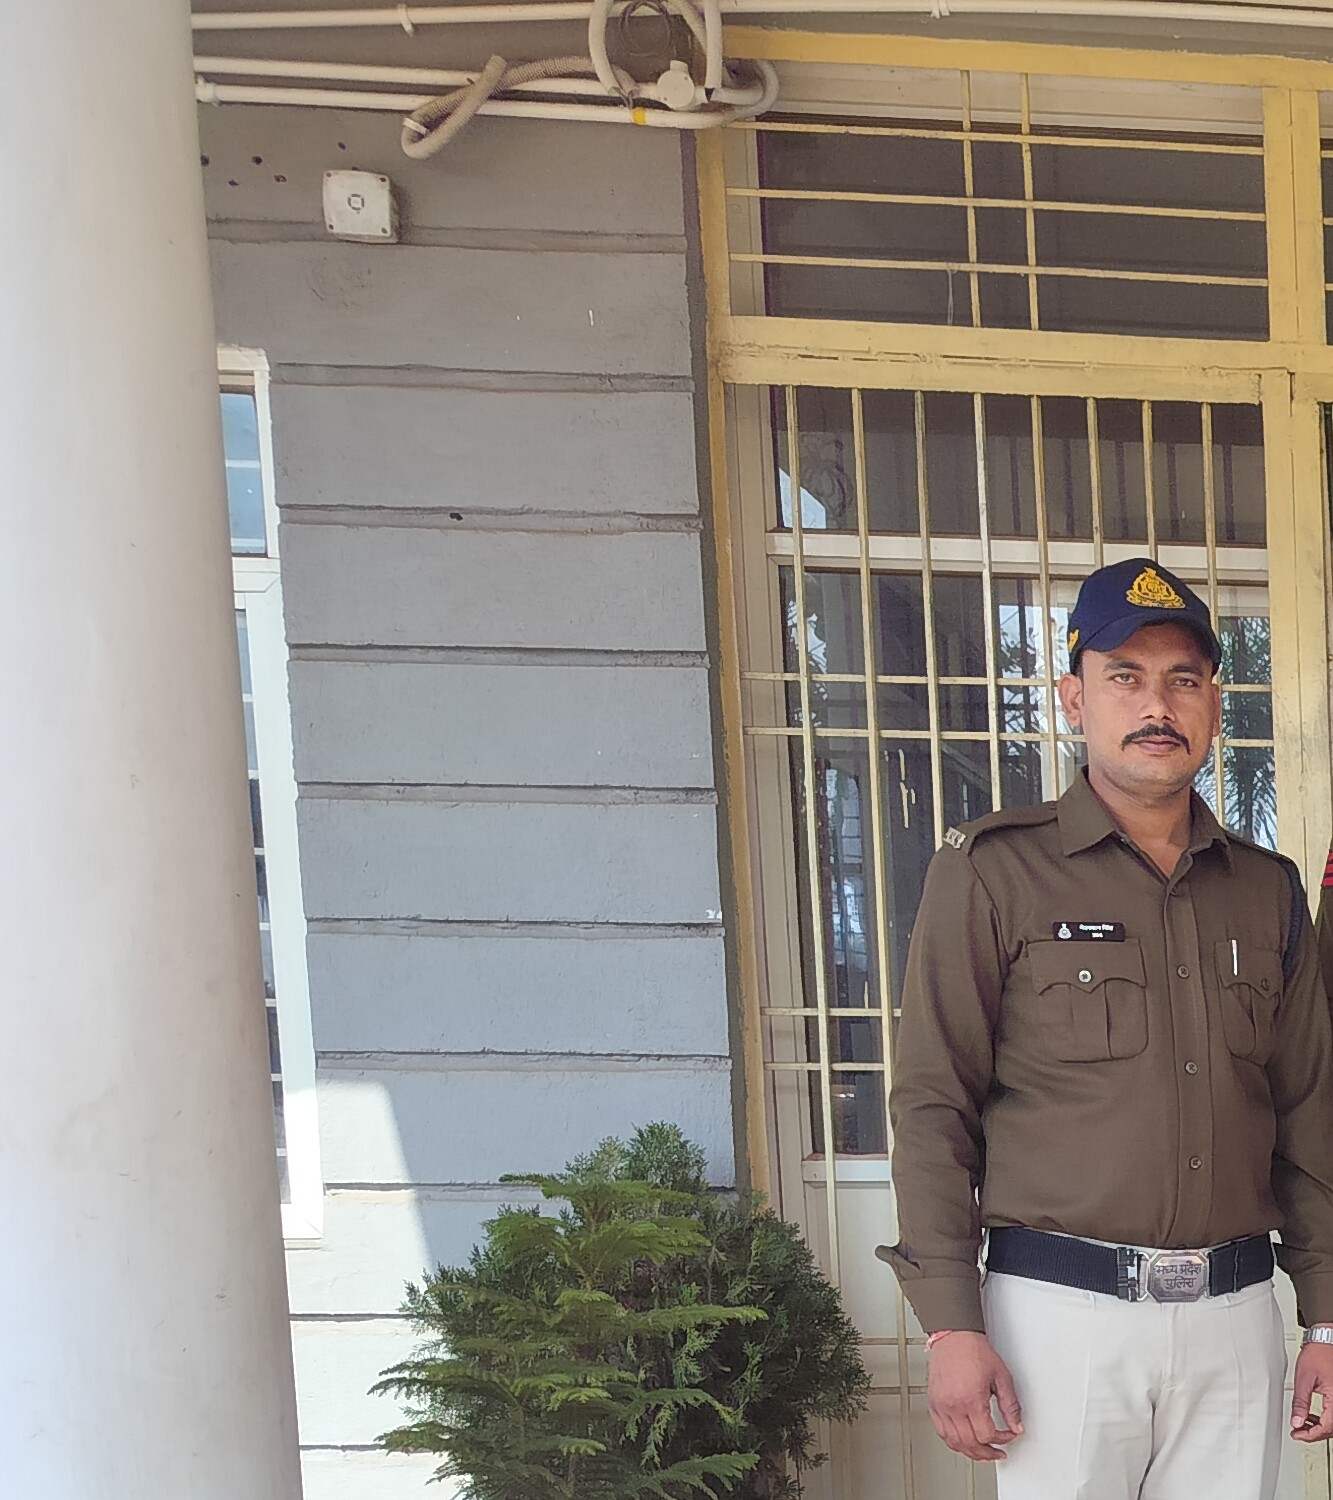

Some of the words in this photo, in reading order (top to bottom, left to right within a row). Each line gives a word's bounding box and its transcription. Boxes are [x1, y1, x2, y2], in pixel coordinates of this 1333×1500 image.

[1155, 1264, 1178, 1275] मध्य
[1179, 1259, 1203, 1276] प्रदेश
[1163, 1275, 1198, 1290] पुलिस
